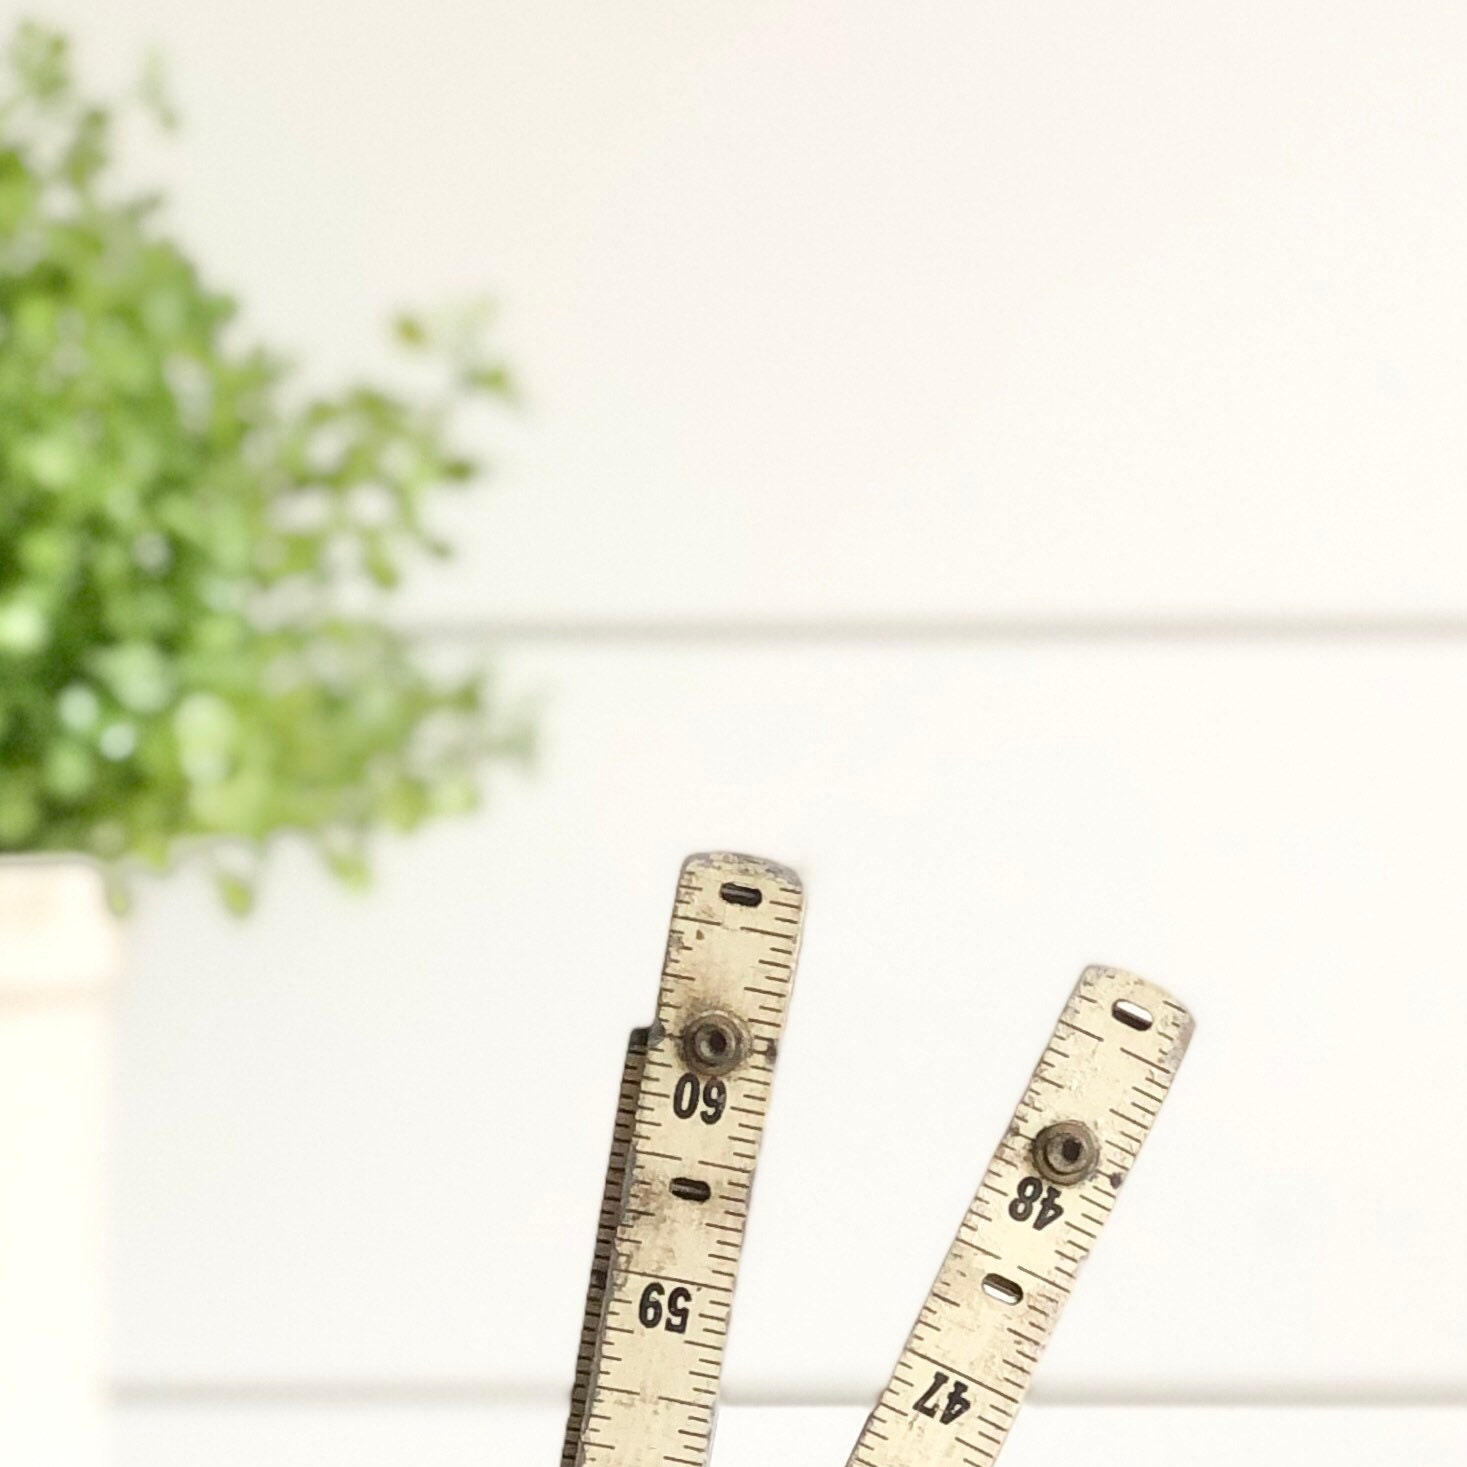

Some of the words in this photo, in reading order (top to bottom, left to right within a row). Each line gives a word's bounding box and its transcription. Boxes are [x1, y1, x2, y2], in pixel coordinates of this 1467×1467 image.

[673, 1073, 727, 1126] 60
[1009, 1176, 1064, 1231] 48
[638, 1282, 692, 1333] 59
[912, 1372, 971, 1426] 47
